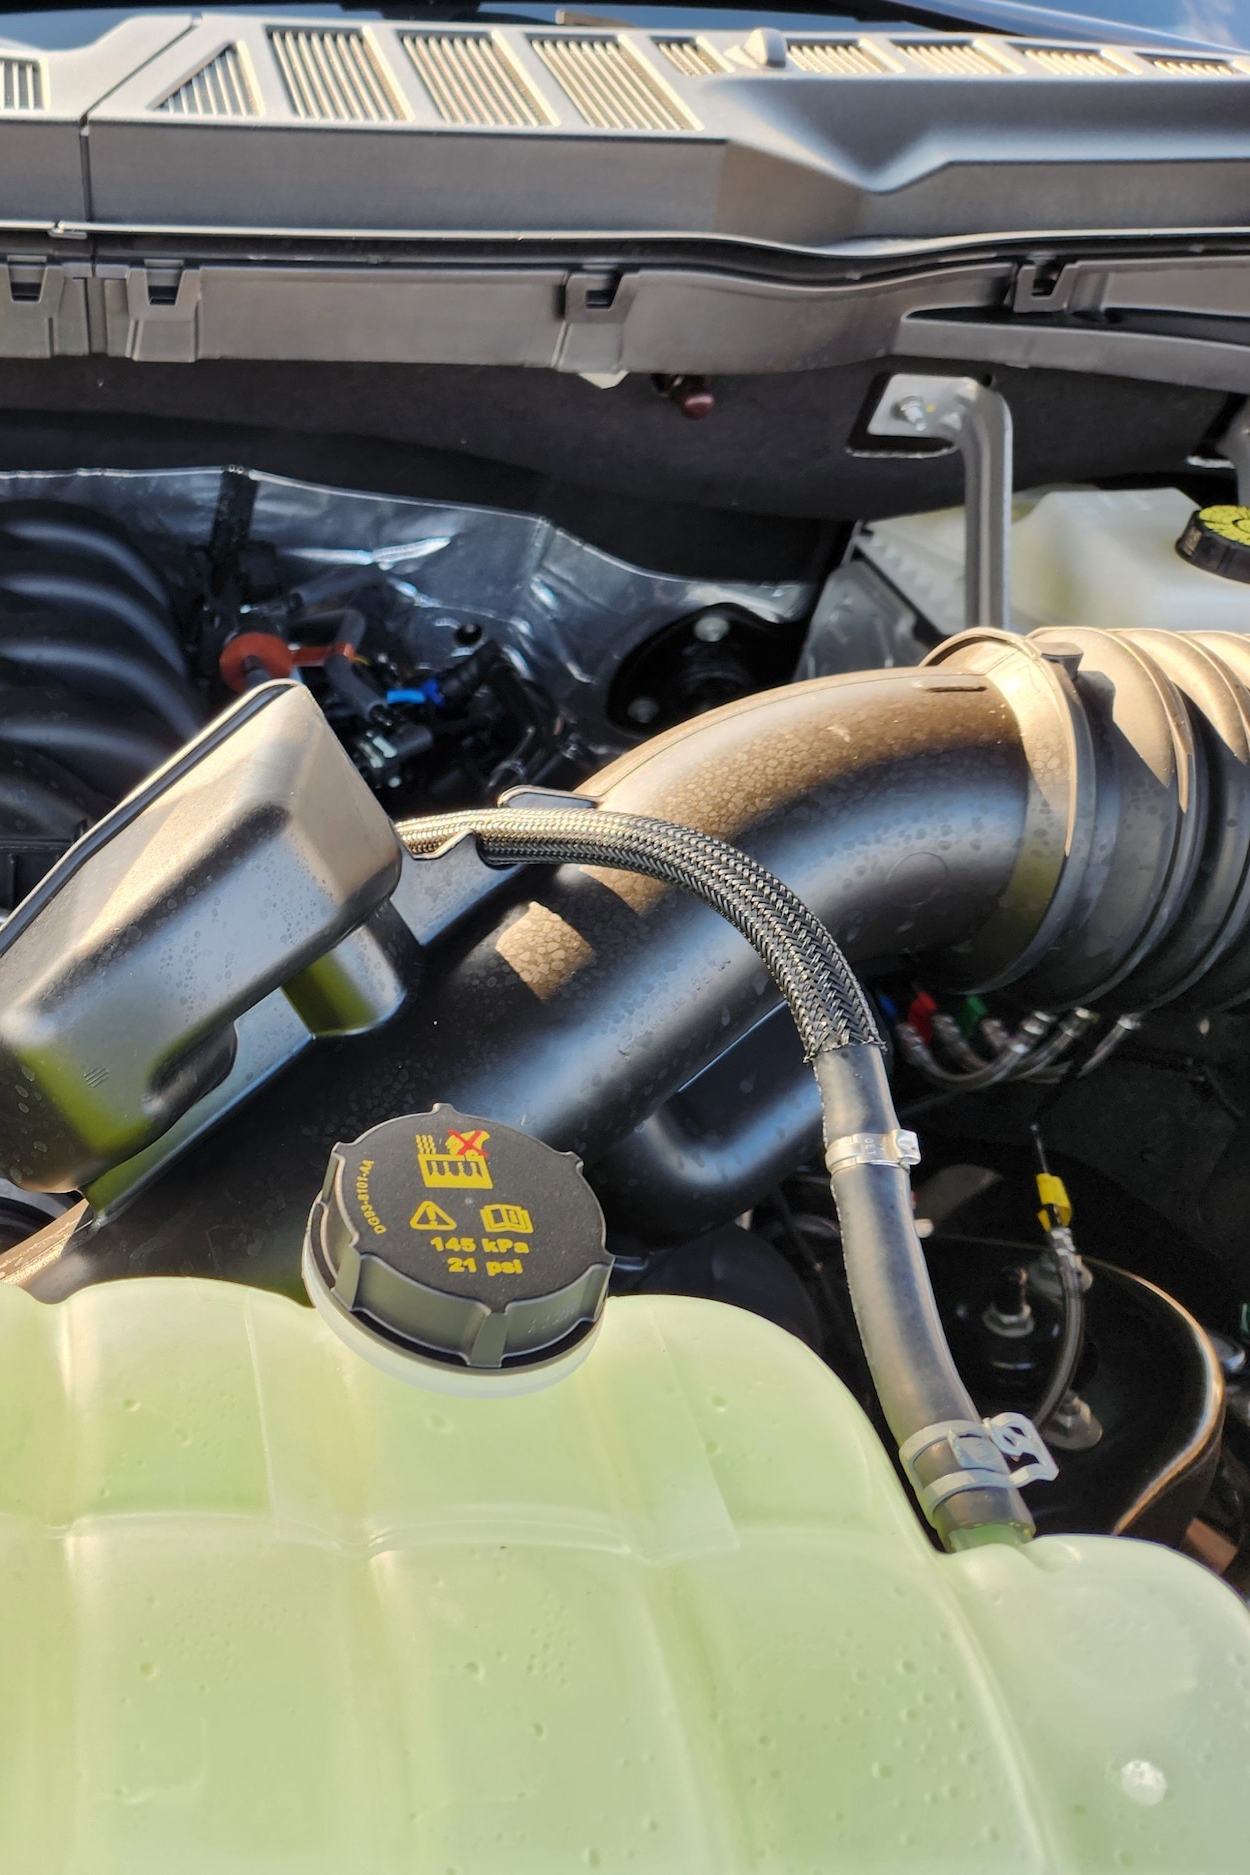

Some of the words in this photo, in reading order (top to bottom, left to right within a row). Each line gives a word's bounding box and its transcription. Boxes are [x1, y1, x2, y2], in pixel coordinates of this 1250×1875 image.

[430, 1236, 477, 1253] 145
[481, 1237, 530, 1254] kPa
[446, 1256, 478, 1273] 21
[485, 1258, 524, 1277] psi
